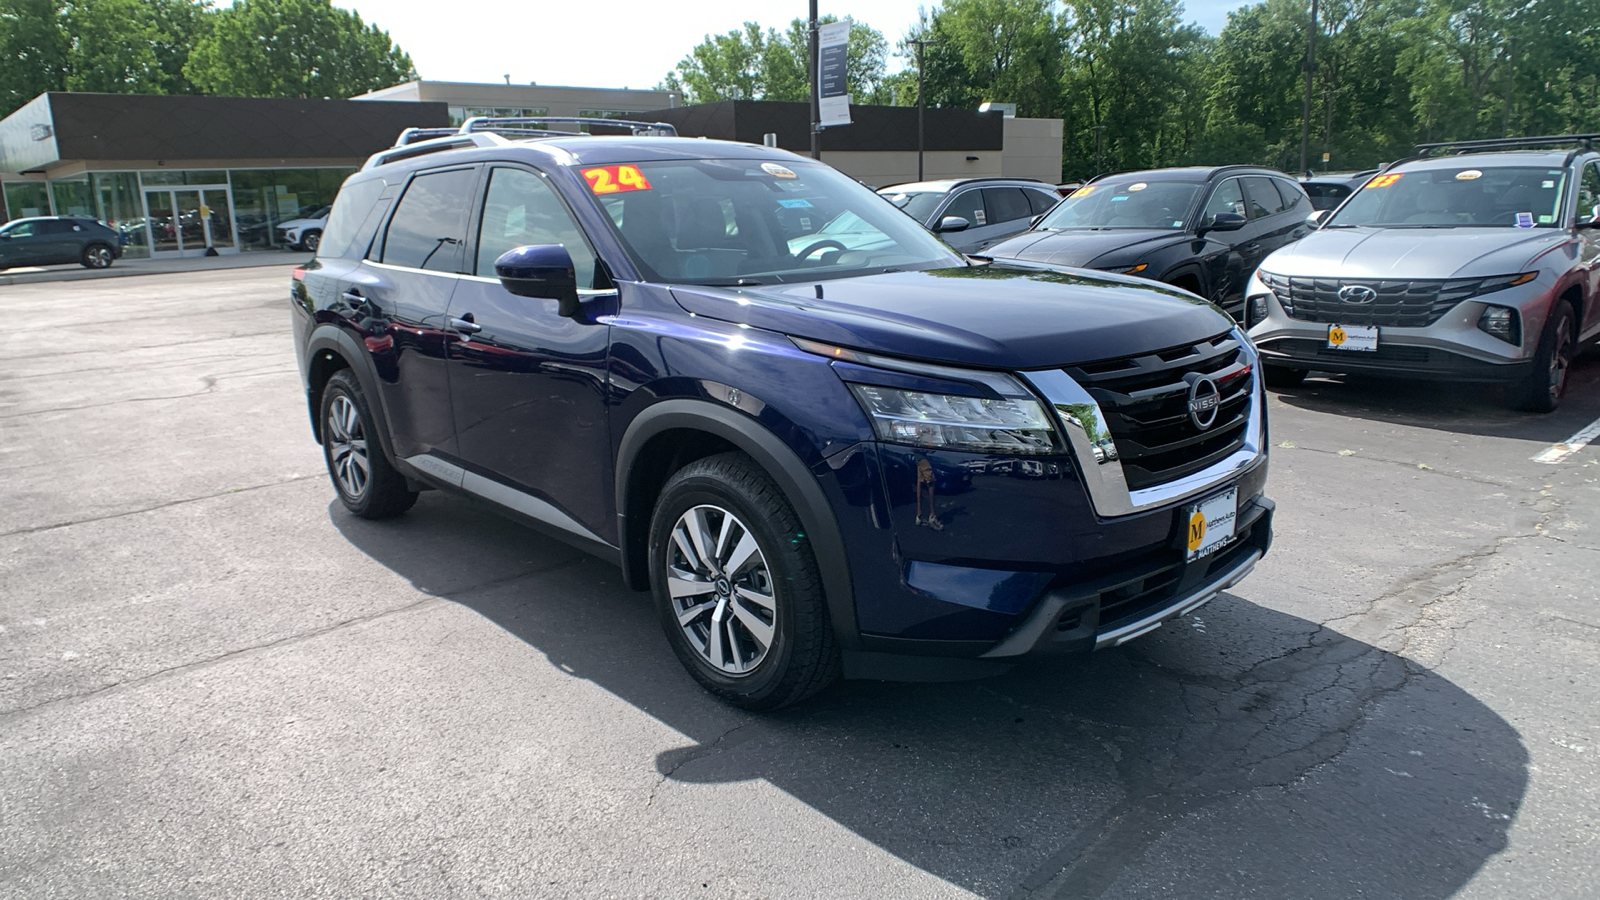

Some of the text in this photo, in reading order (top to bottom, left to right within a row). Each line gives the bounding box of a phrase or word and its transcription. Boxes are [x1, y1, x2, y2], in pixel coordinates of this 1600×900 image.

[584, 165, 648, 193] 24
[1364, 173, 1403, 189] 23
[1333, 332, 1344, 341] M
[1189, 520, 1204, 544] M
[1198, 537, 1228, 560] MATTHEWS
